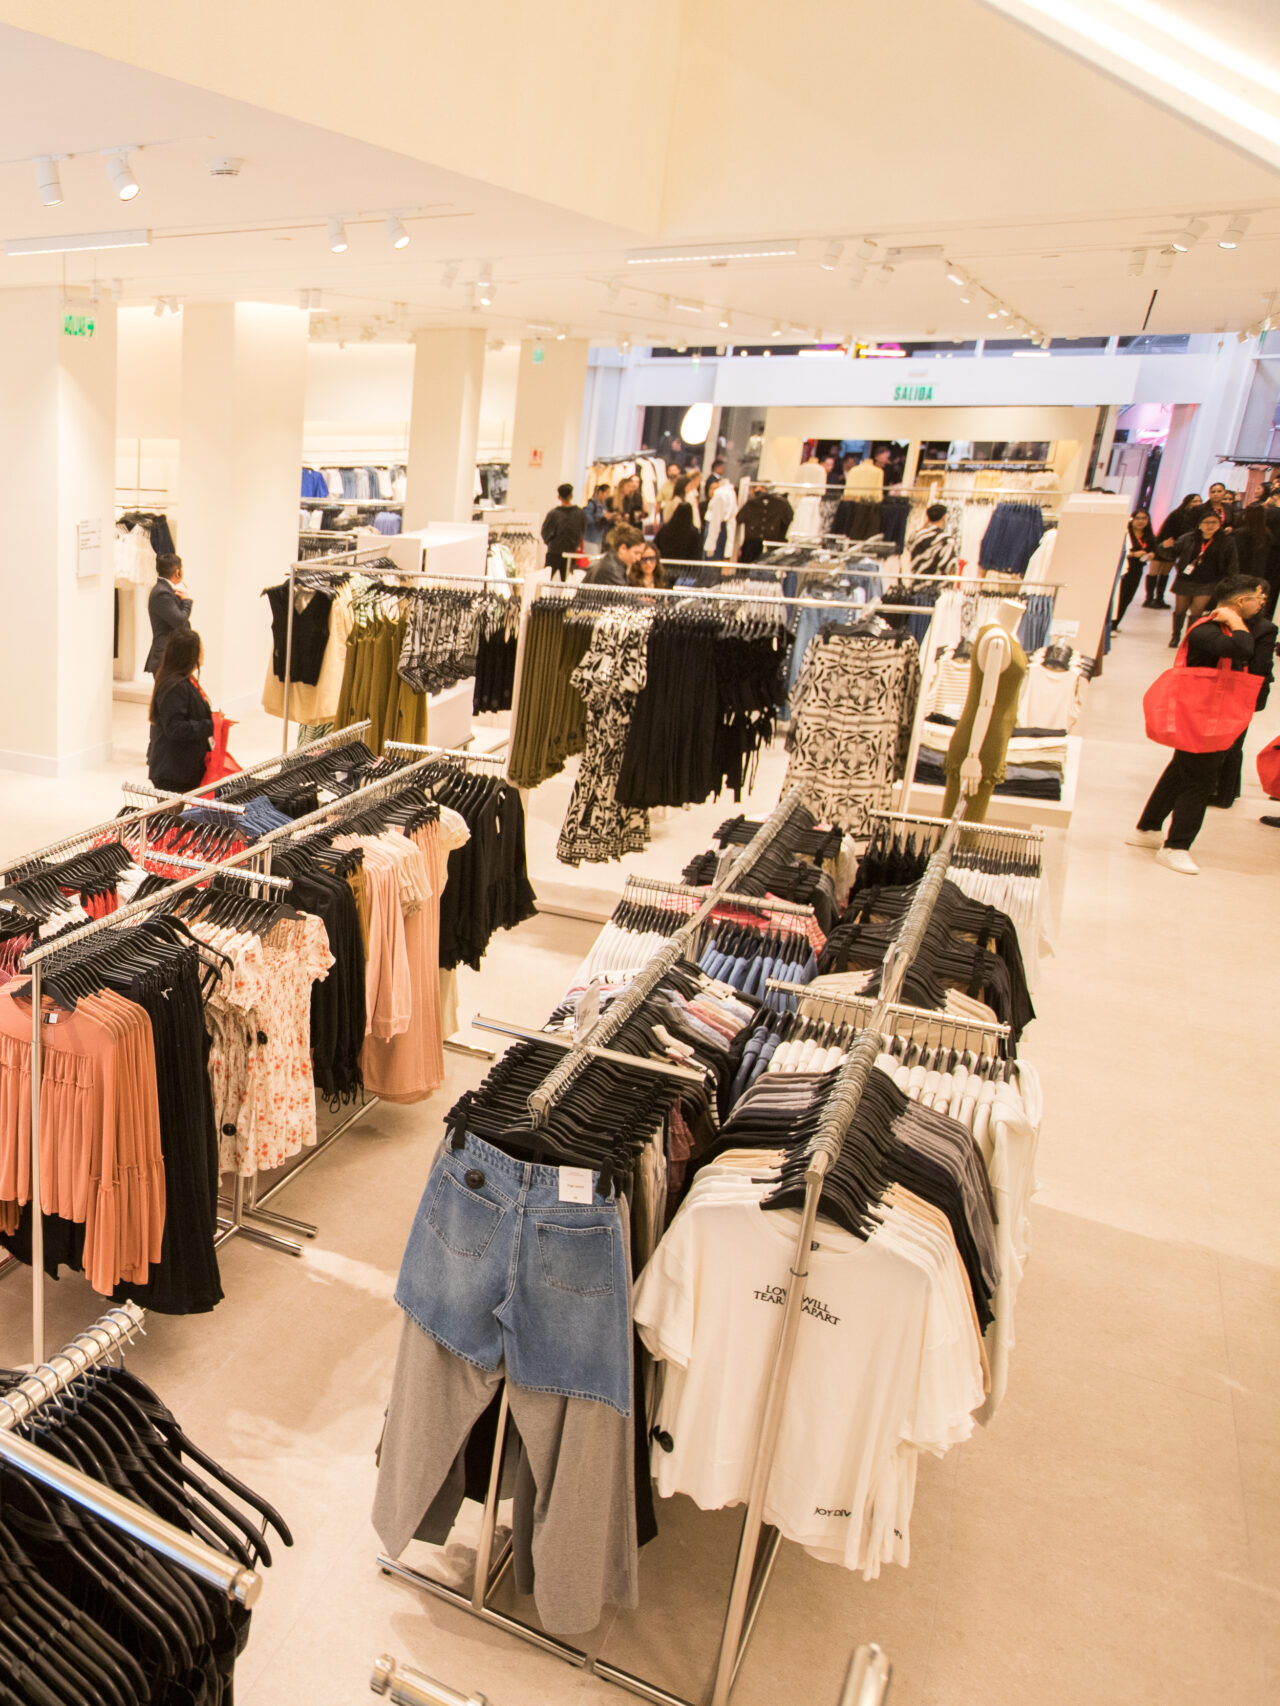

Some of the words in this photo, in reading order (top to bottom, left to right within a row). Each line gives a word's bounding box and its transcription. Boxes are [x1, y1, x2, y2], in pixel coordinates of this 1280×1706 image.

[894, 385, 933, 401] SALIDA
[754, 1290, 785, 1305] TEAR
[801, 1304, 841, 1325] APART
[802, 1294, 830, 1313] WILL
